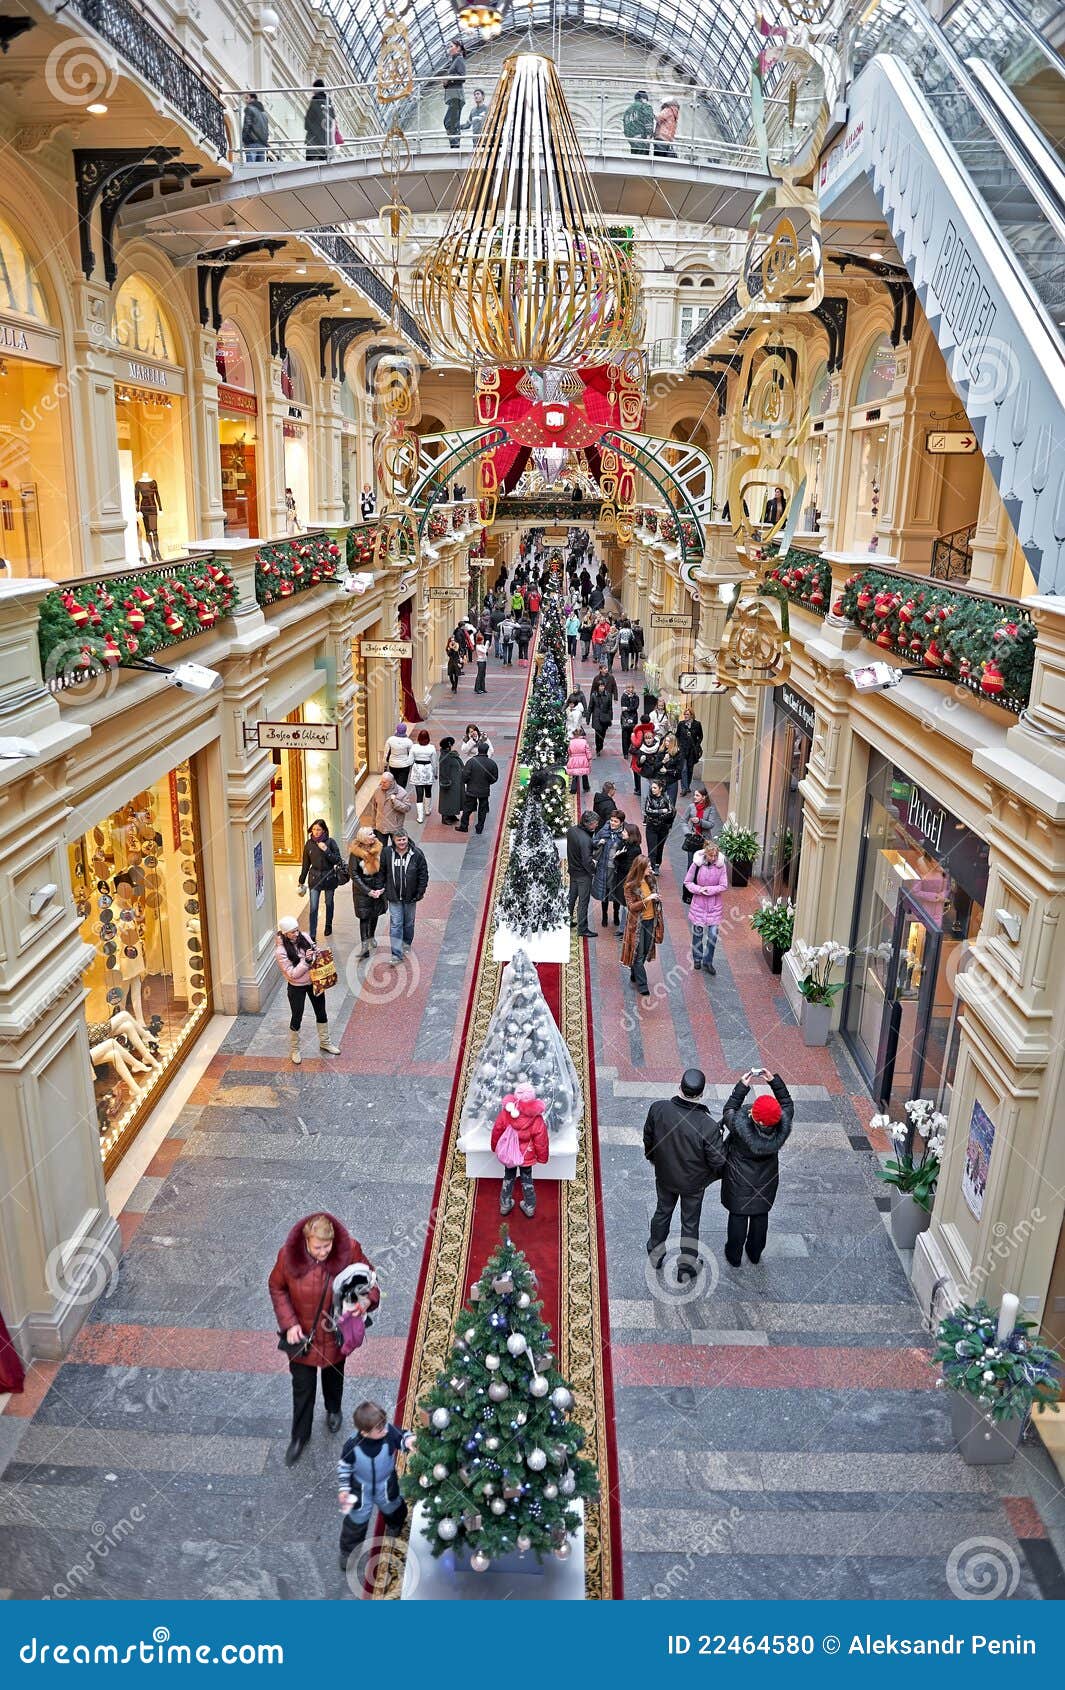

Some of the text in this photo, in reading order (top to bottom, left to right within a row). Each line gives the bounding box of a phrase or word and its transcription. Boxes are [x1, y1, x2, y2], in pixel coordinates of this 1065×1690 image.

[931, 219, 997, 384] RIEDEL
[128, 361, 168, 386] MARELLA
[908, 785, 947, 852] PIAGET
